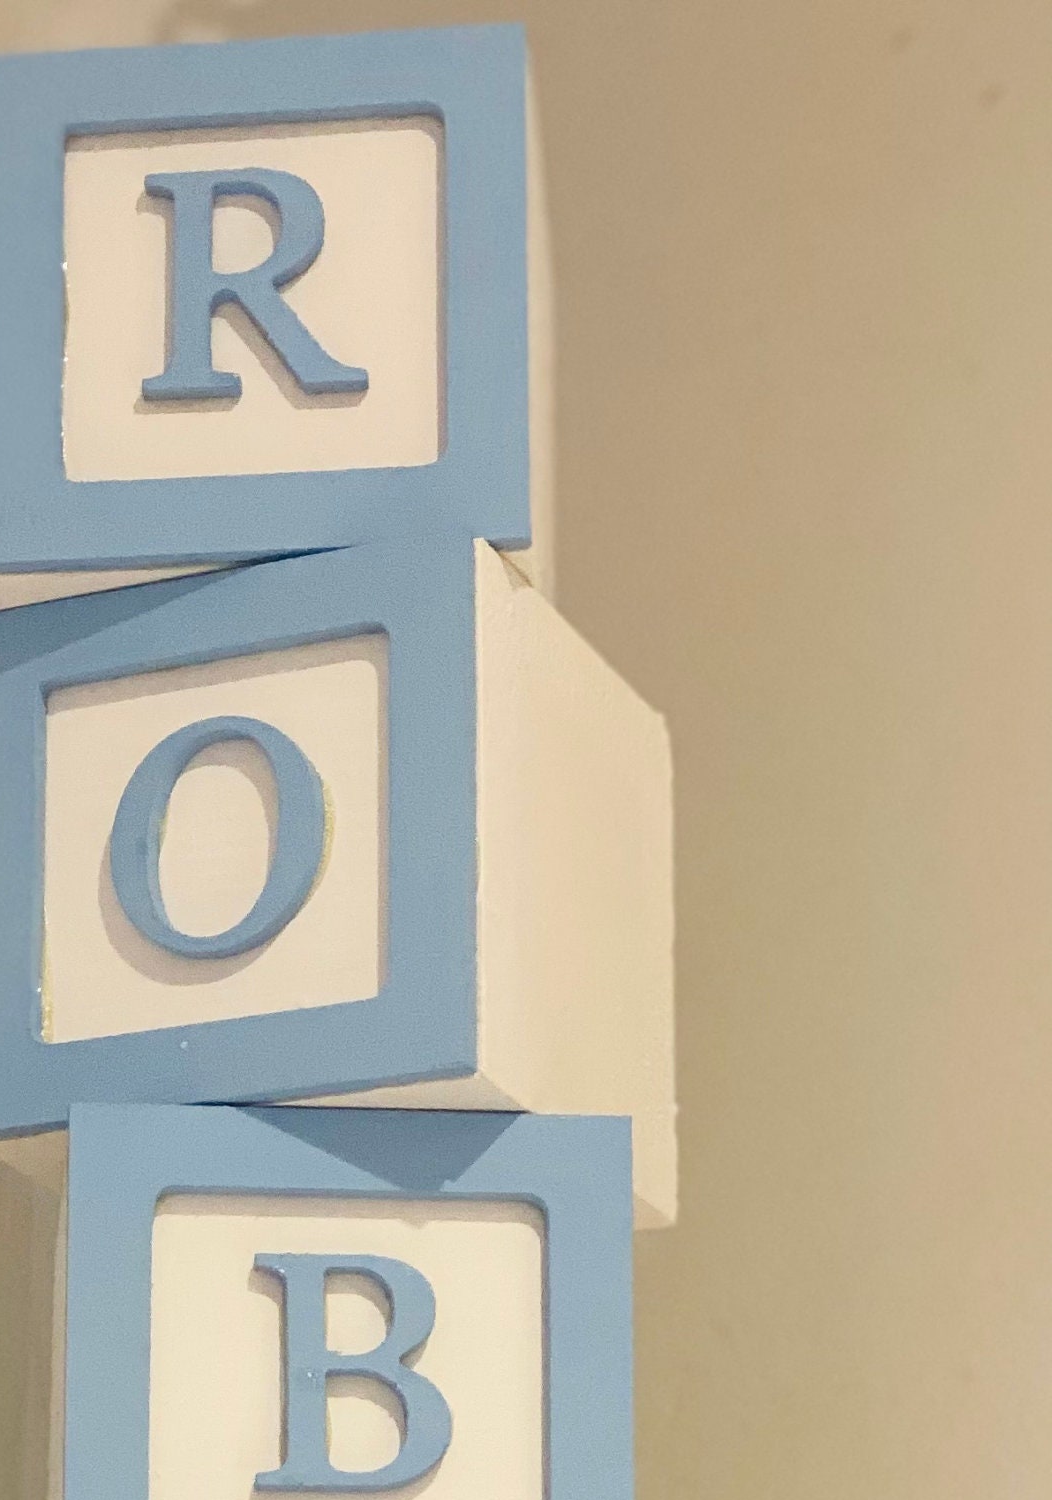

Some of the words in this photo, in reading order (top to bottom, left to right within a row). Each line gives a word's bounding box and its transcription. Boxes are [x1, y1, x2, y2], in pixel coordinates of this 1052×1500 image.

[142, 168, 368, 402] R
[110, 716, 328, 957] O
[255, 1254, 451, 1491] B
